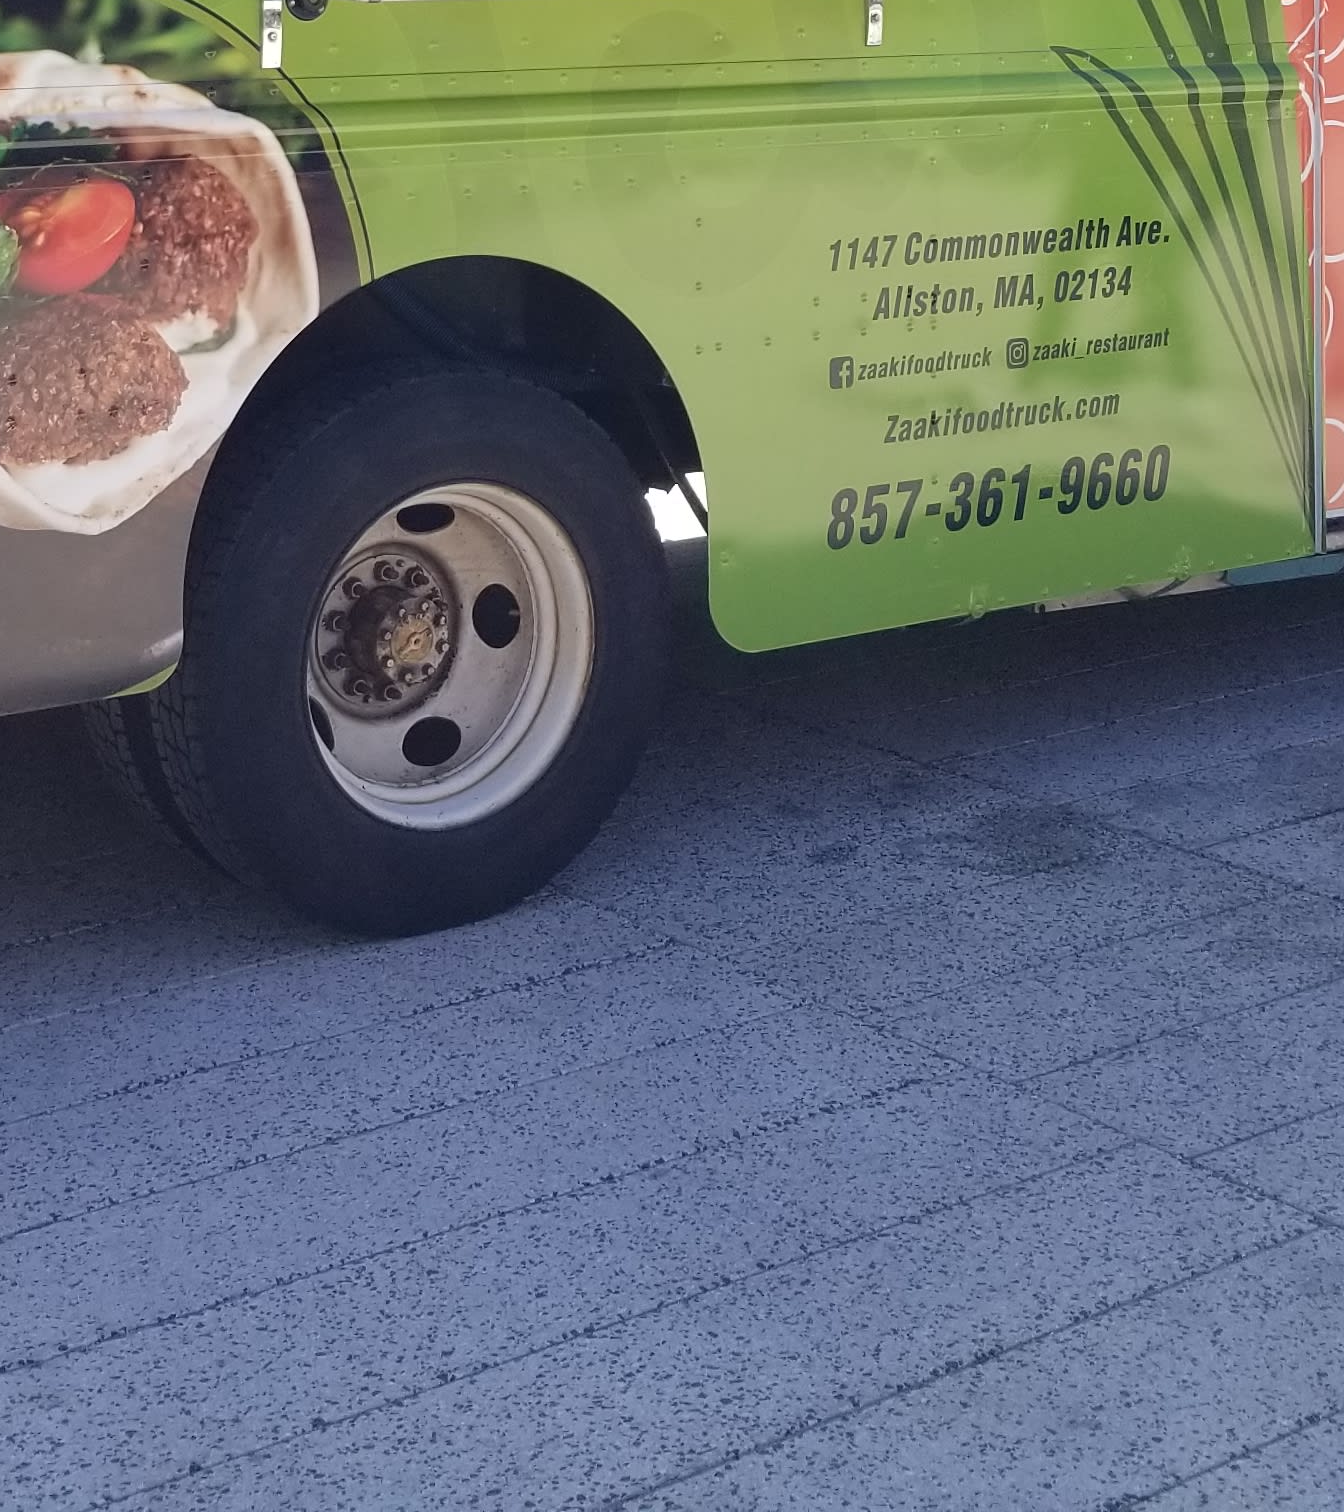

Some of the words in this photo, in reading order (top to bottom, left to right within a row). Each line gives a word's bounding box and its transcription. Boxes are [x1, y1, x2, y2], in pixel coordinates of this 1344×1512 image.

[829, 234, 898, 272] 1147
[904, 218, 1111, 266] Commonwealth
[1116, 215, 1171, 248] Ave.
[872, 283, 984, 321] Allston,
[993, 273, 1045, 310] MA,
[1053, 265, 1133, 303] 02134
[857, 346, 993, 381] zaakifoodtruck
[1032, 327, 1170, 362] zaaki_restaurant
[883, 393, 1120, 444] Zaakifoodtruck.com
[826, 444, 1172, 551] 857-361-9660
